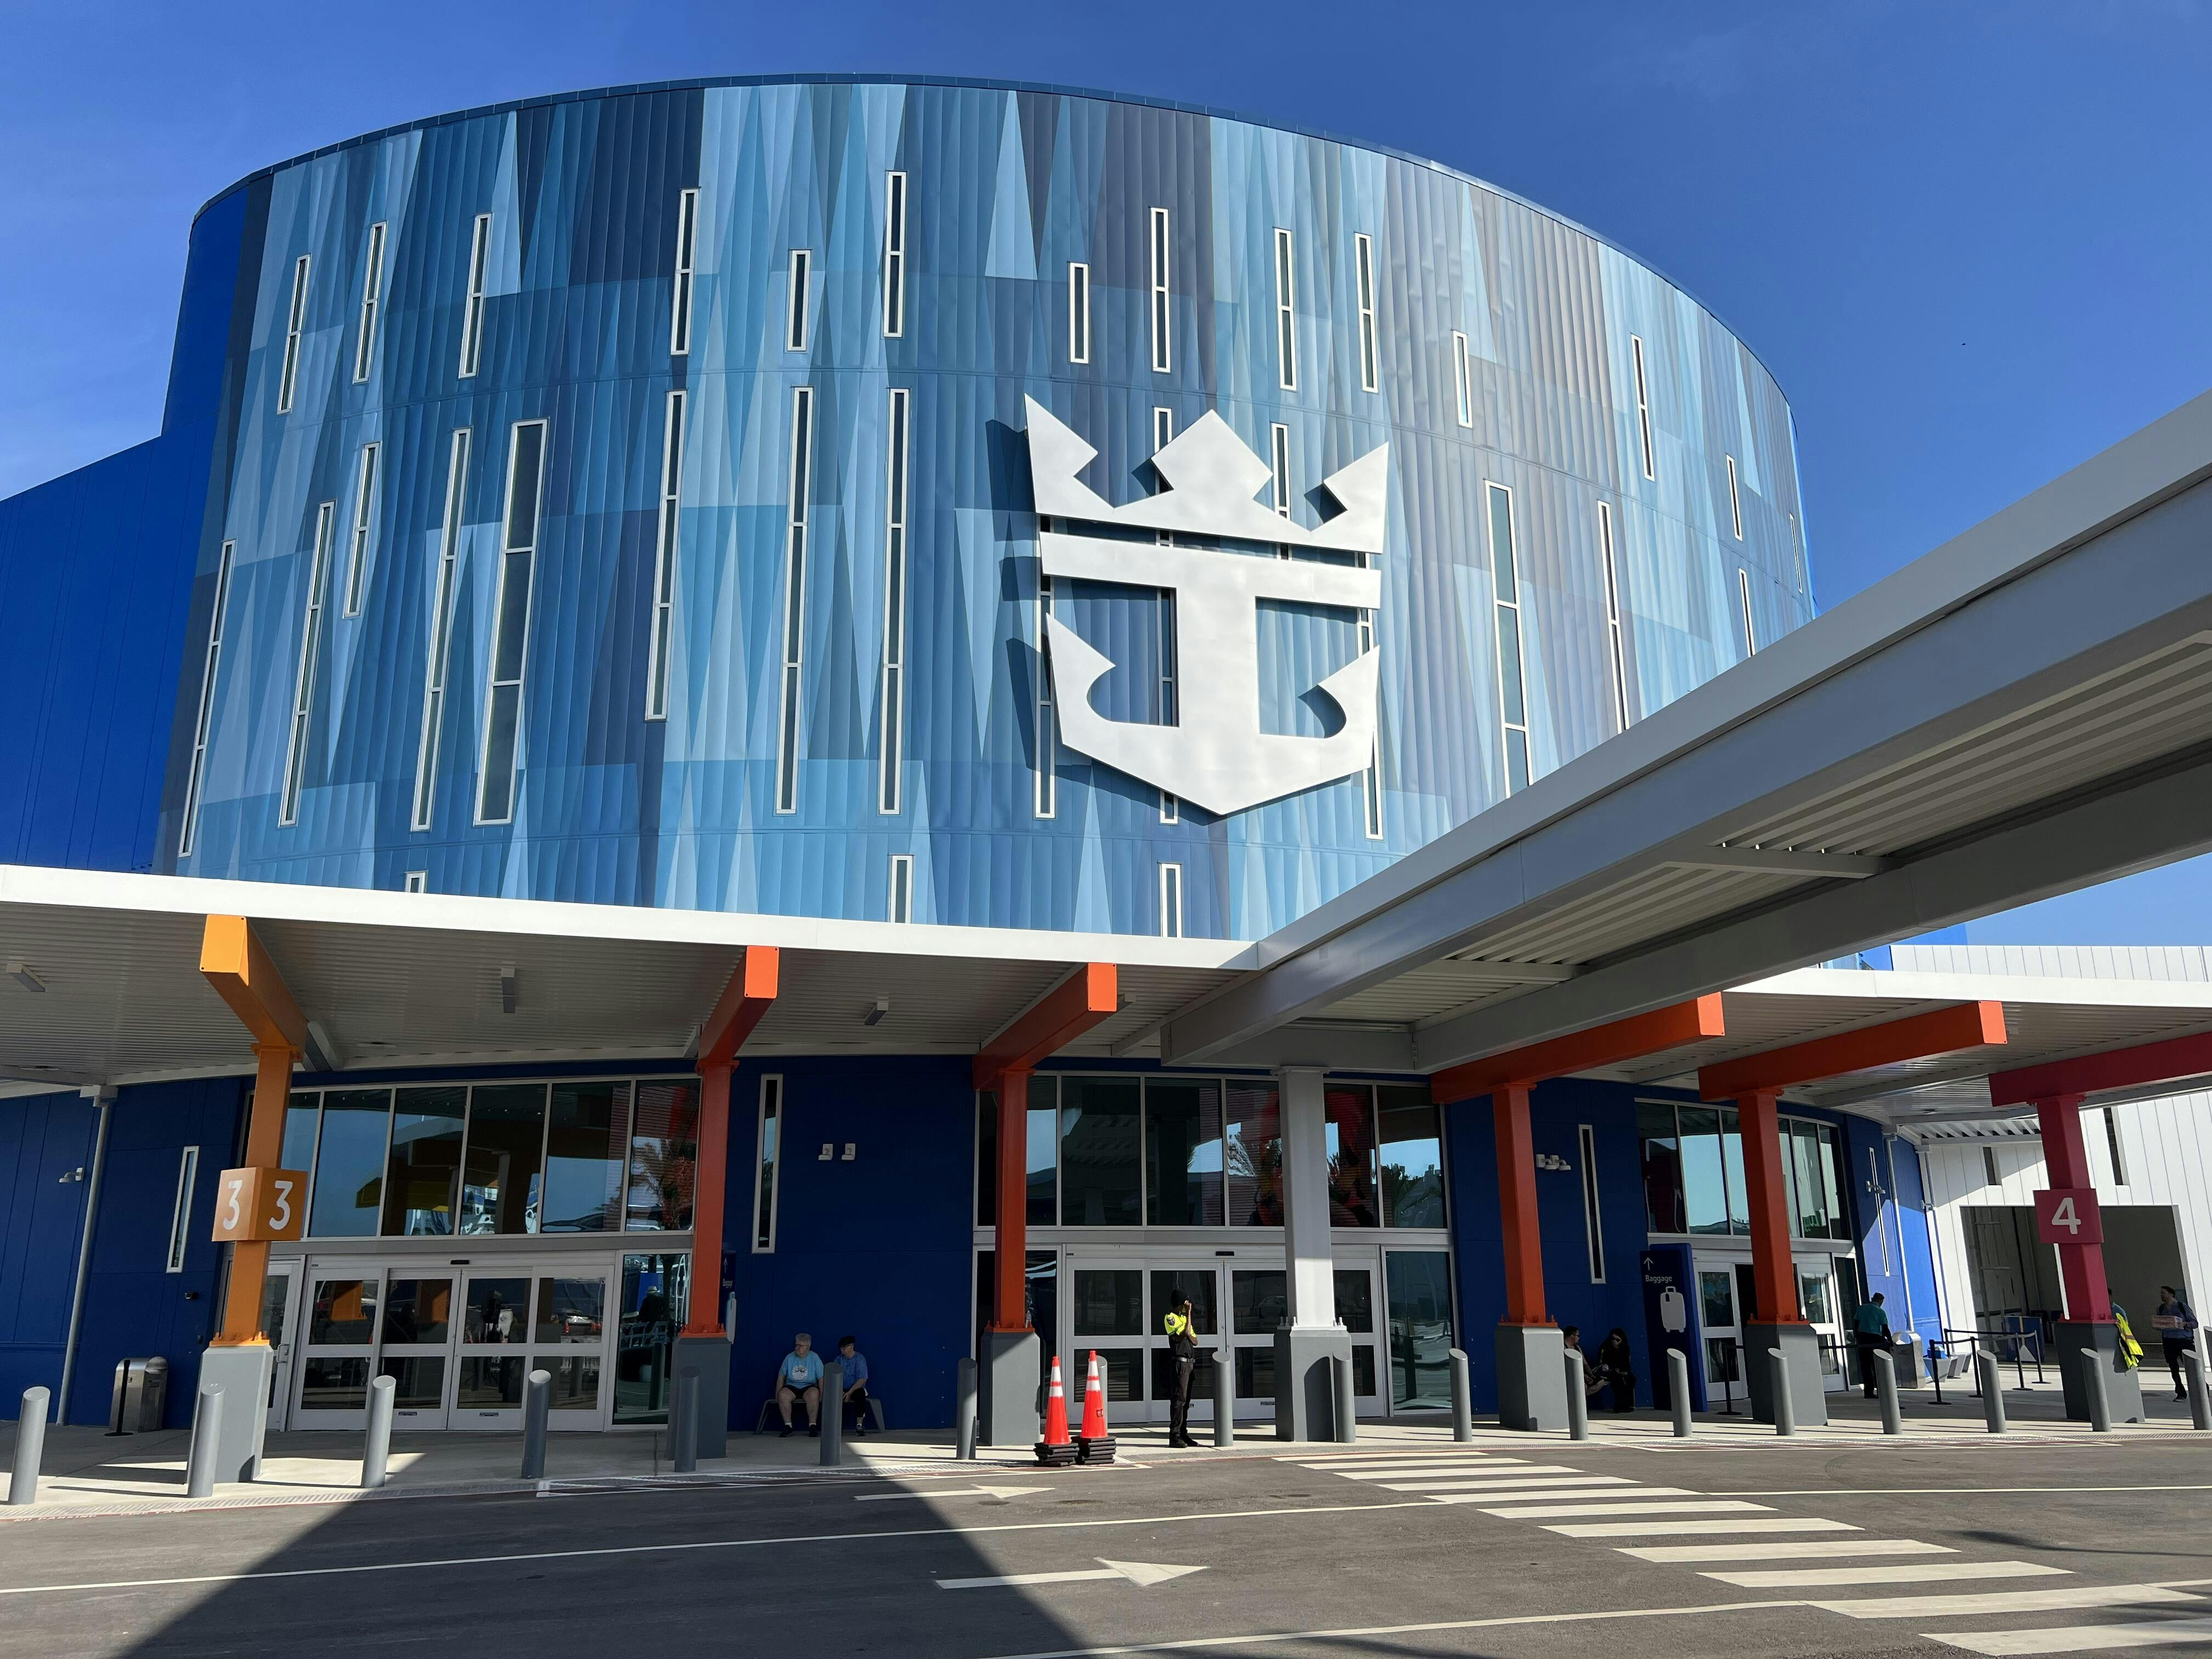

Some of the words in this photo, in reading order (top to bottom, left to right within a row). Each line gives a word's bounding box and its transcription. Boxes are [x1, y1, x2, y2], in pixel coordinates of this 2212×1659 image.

[223, 1180, 242, 1230] 3
[269, 1180, 293, 1230] 3
[2051, 1197, 2081, 1235] 4
[1645, 1274, 1673, 1283] Baggage
